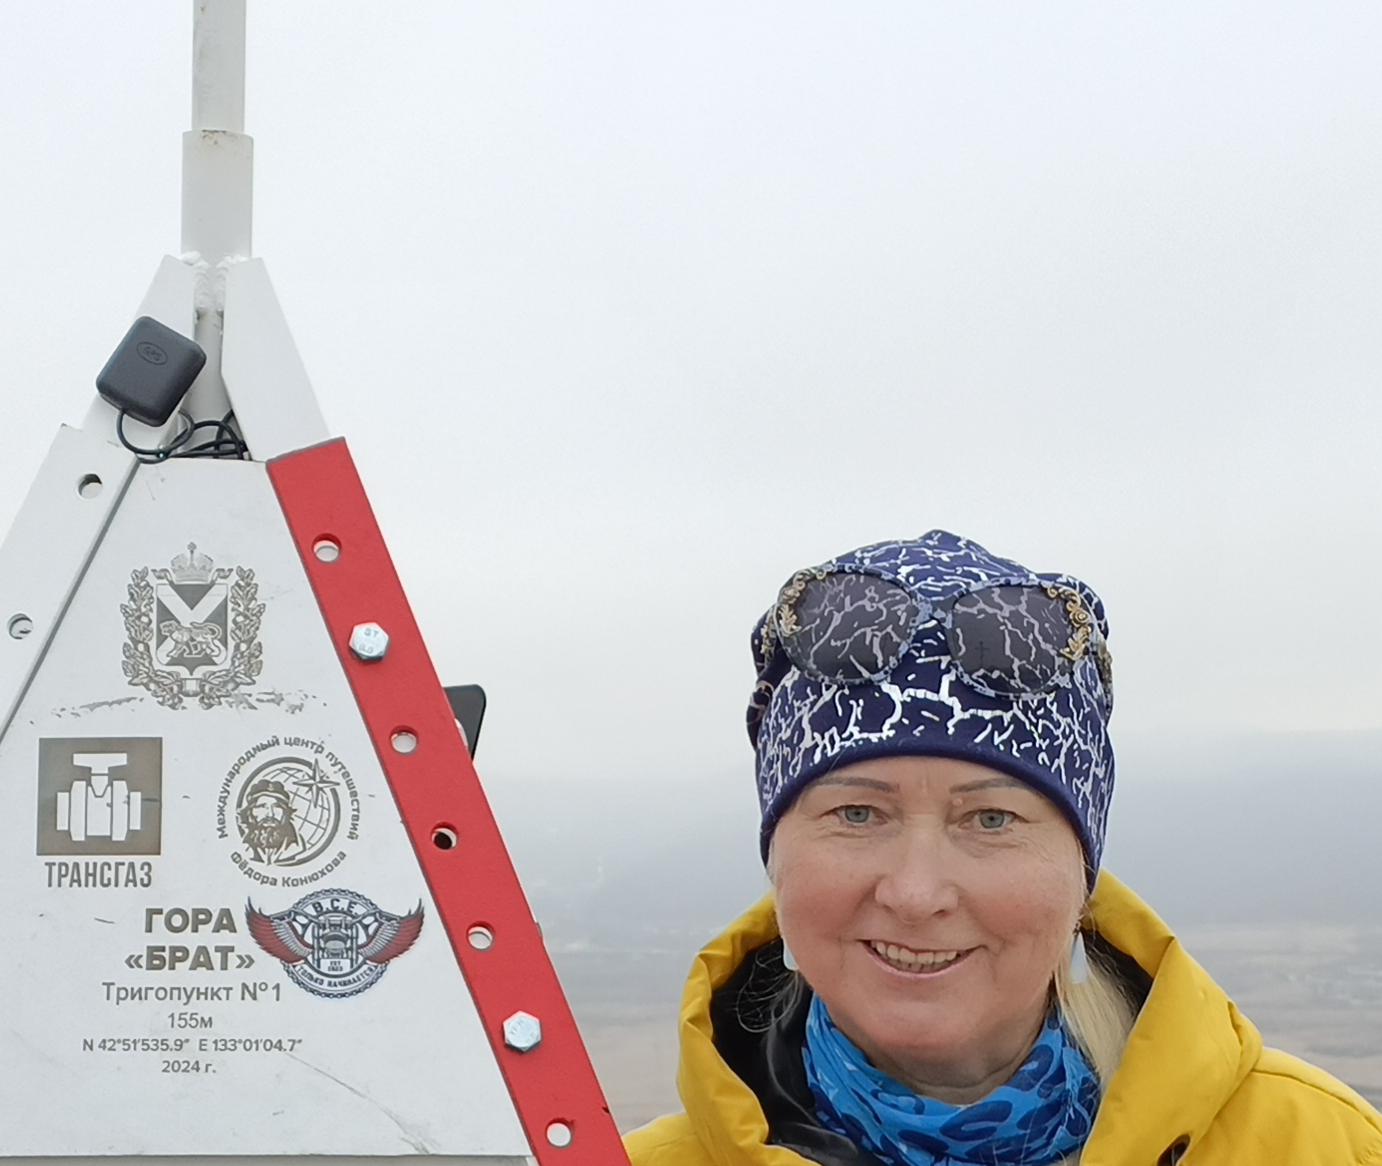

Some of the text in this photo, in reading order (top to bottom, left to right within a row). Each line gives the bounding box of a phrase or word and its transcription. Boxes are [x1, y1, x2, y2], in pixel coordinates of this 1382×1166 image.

[216, 735, 360, 841] Международный центр путешествий
[44, 861, 153, 888] ТРАНСГАЗ
[230, 850, 347, 887] Фёдора Конюхова
[144, 907, 238, 934] ГОРА
[124, 945, 256, 971] «БРАТ»
[101, 981, 234, 1006] Тригопункт
[166, 1012, 214, 1029] 155м
[82, 1038, 94, 1052] N
[199, 1038, 208, 1052] E
[161, 1060, 217, 1074] 2024 г.
